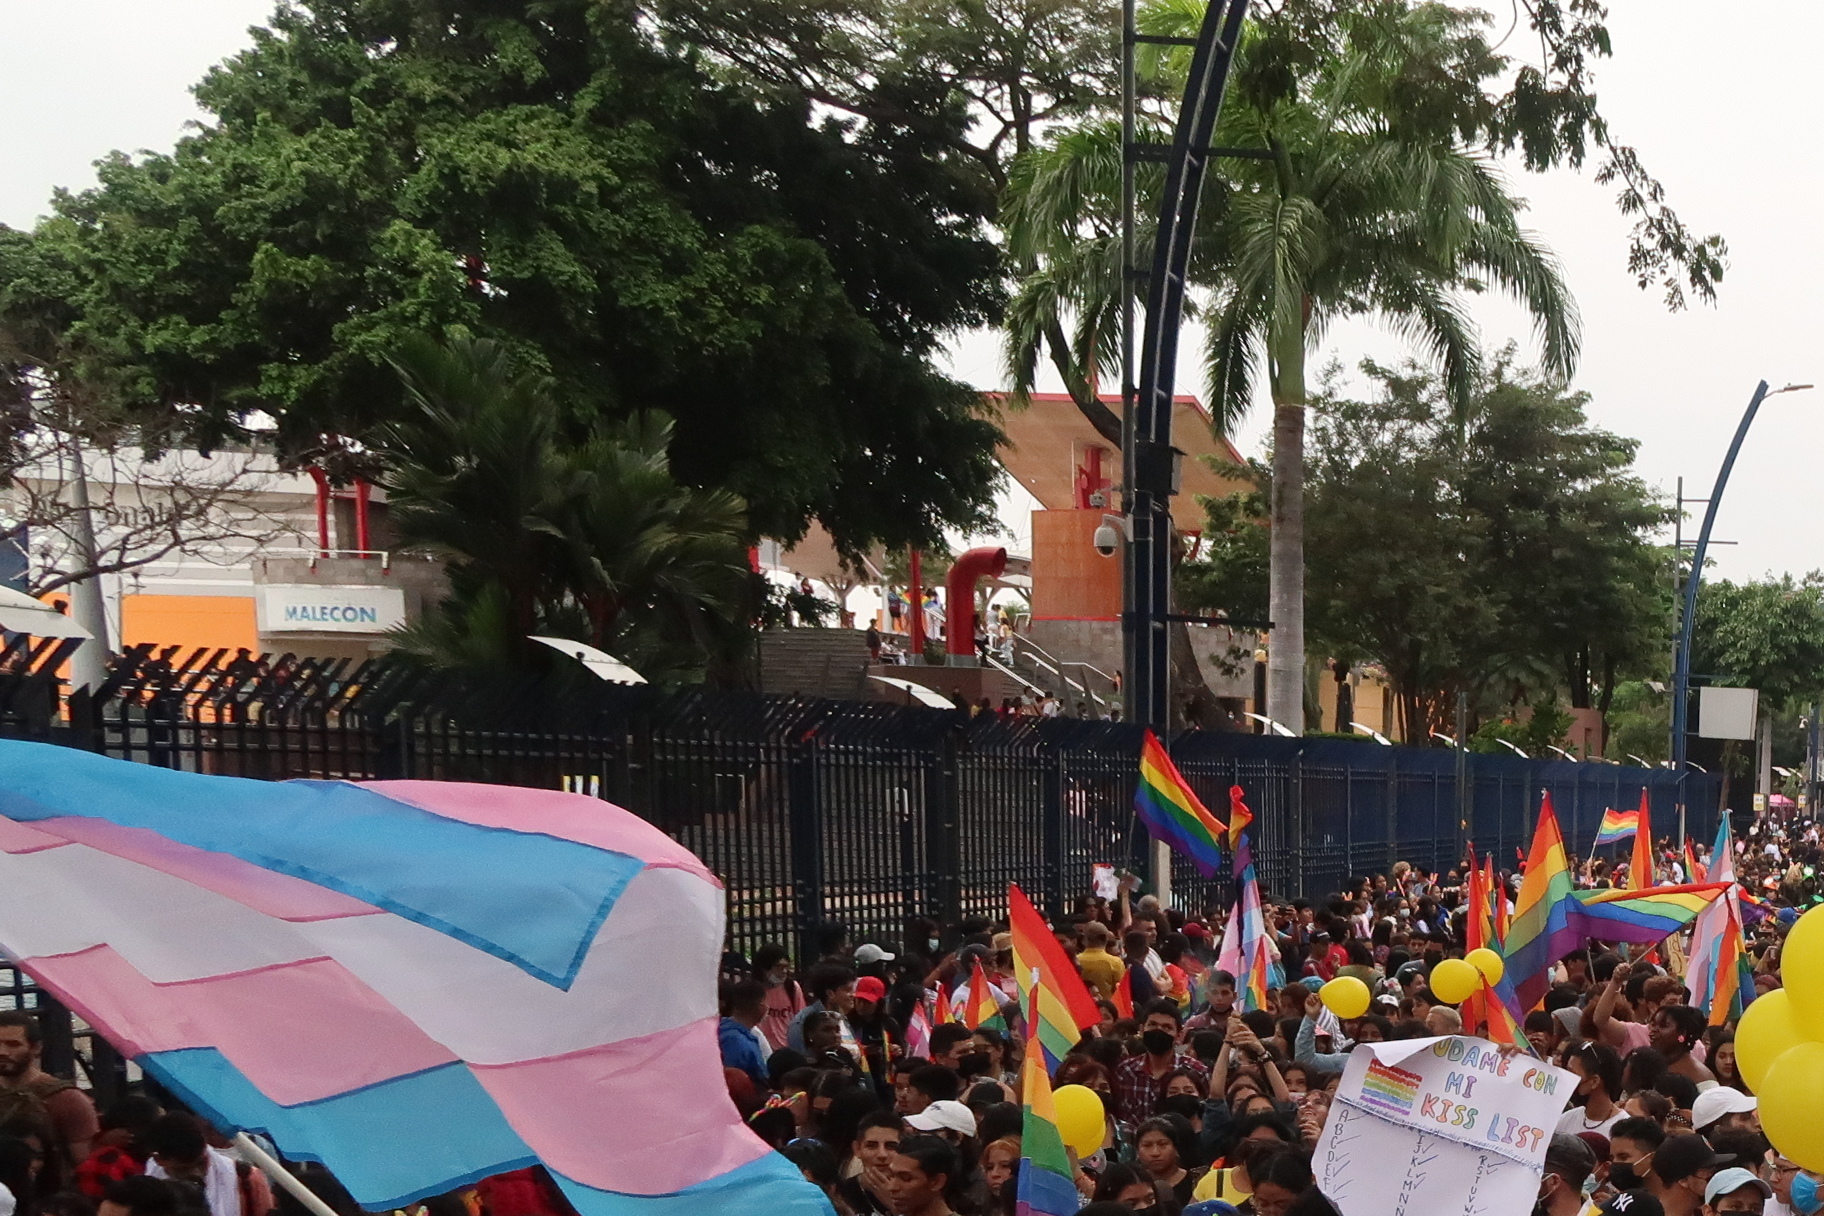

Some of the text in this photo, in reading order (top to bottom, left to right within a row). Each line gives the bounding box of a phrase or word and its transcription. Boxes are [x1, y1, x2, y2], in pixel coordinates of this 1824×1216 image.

[1445, 1072, 1477, 1099] MI
[1522, 1068, 1558, 1095] CON
[1420, 1093, 1479, 1129] KISS
[1486, 1113, 1544, 1152] LIST
